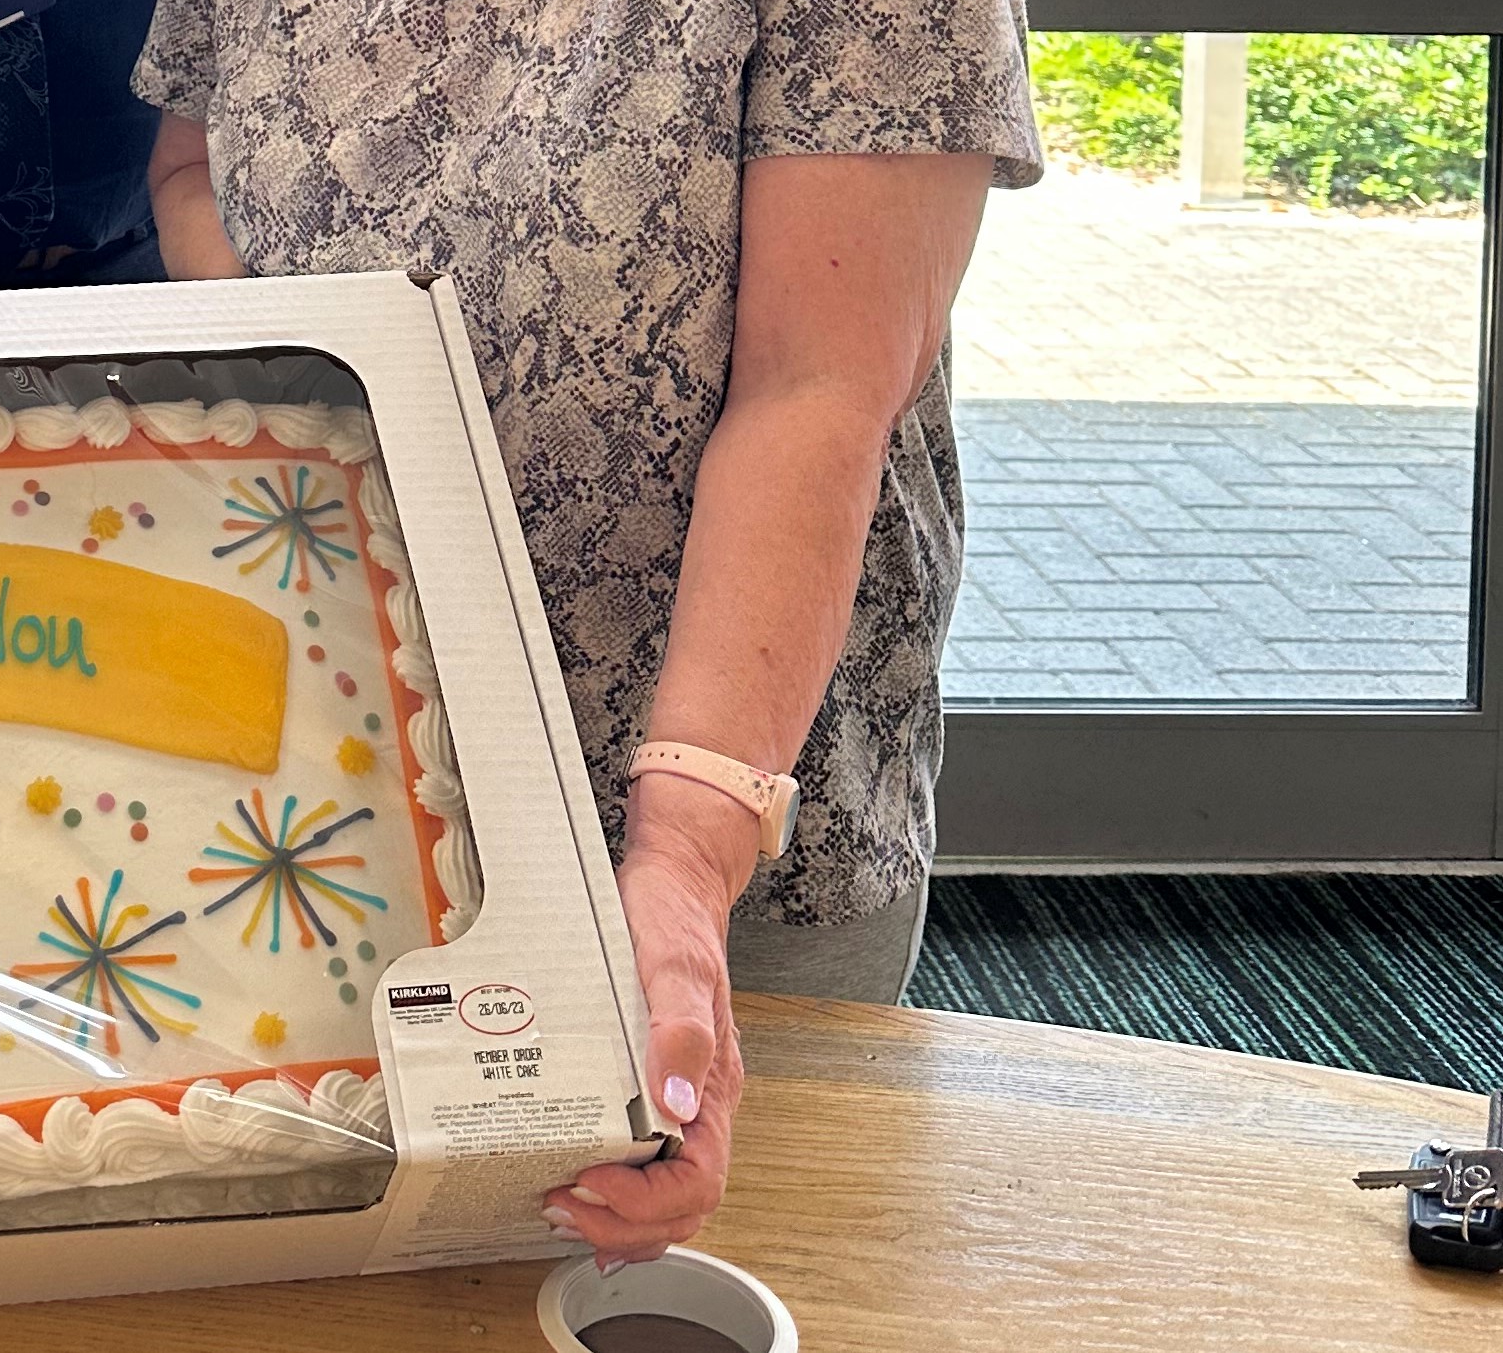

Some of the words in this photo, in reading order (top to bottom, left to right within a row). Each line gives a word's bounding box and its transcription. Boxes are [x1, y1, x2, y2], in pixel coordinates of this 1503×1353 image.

[391, 985, 449, 1000] KIRKLAND
[478, 1001, 525, 1016] 26/06/23
[474, 1049, 510, 1064] MEMBER
[514, 1047, 544, 1062] ORDER
[482, 1065, 513, 1080] WHITE
[517, 1063, 541, 1078] CAKE
